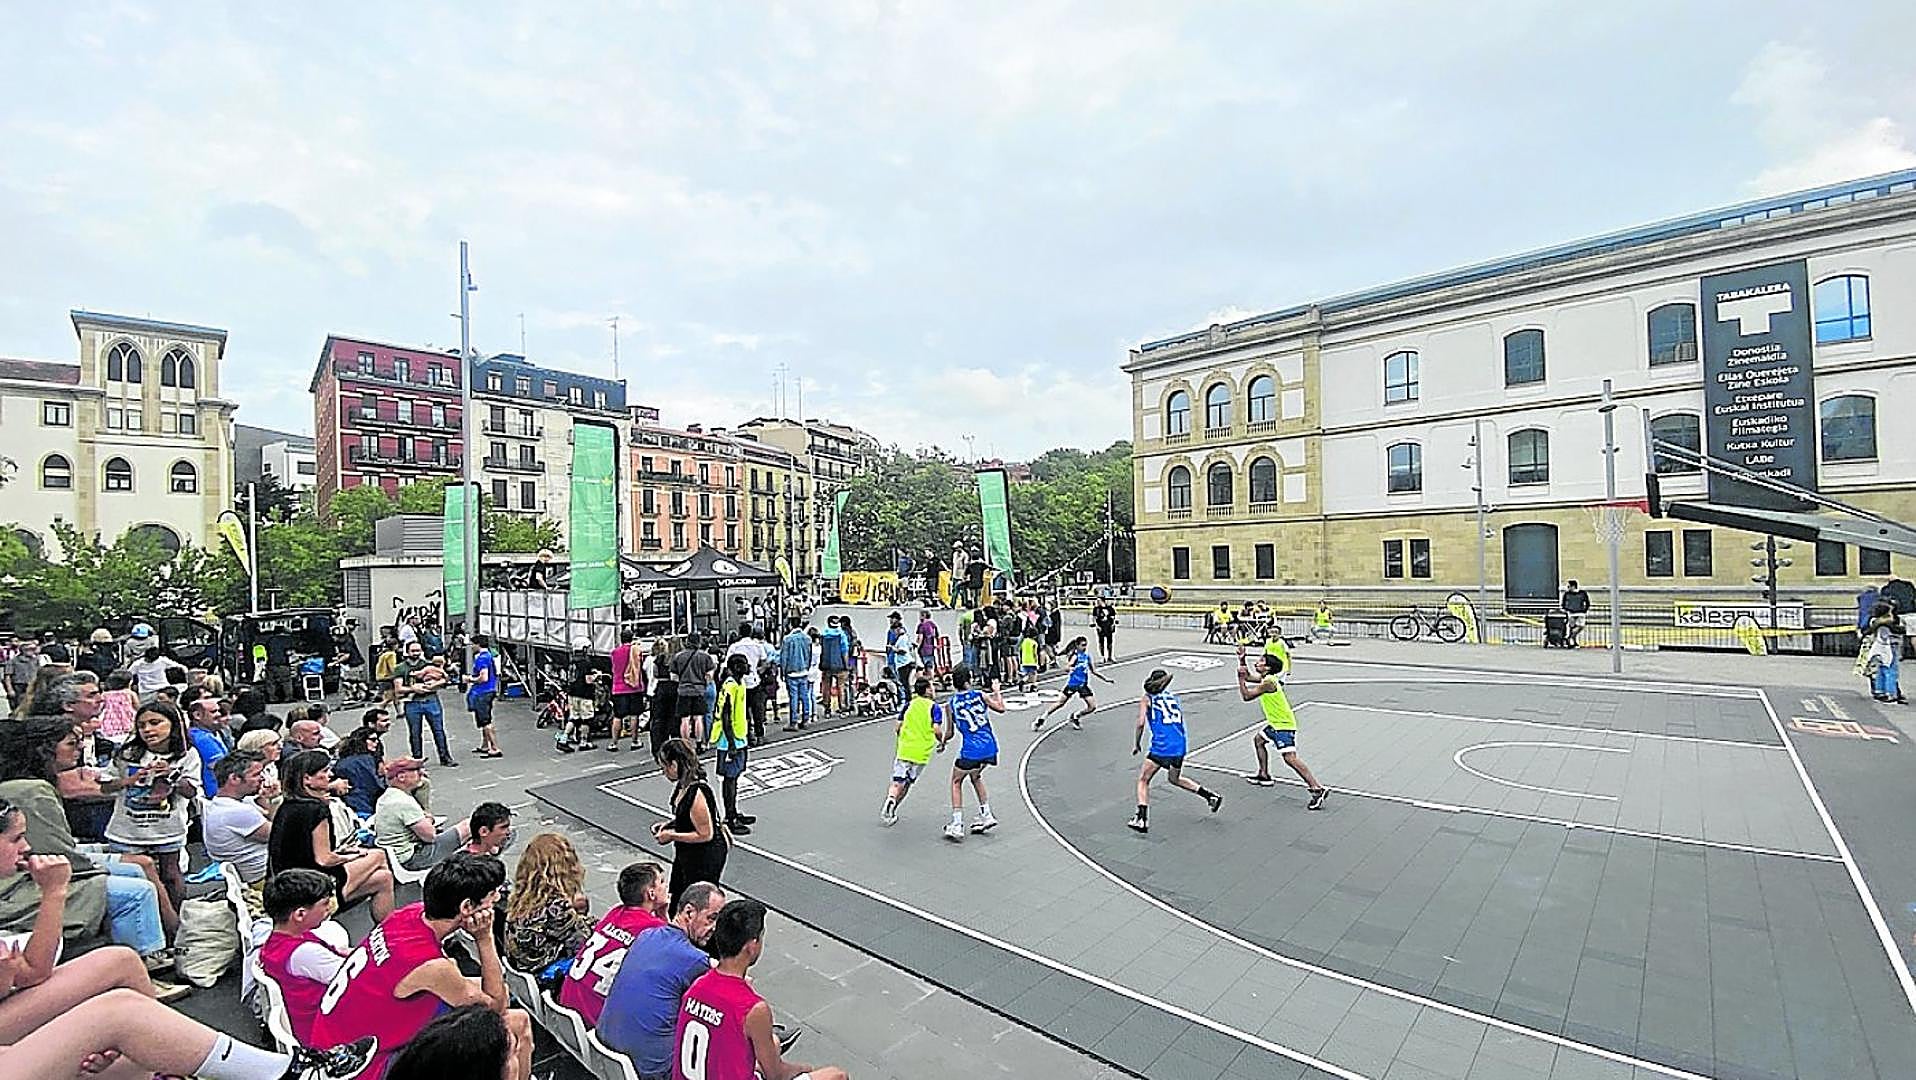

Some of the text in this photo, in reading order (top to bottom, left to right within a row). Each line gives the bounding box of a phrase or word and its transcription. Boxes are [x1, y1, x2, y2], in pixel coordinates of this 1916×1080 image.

[1716, 282, 1791, 301] TABAKALERA
[1732, 343, 1781, 357] Donostia
[1727, 352, 1787, 367] Zinemaldia
[1718, 366, 1799, 382] Elias Querejeta
[1727, 376, 1790, 390] Zine Eskola
[1714, 398, 1805, 415] Euskal Institutua
[1731, 415, 1788, 427] Euskadiko
[1731, 424, 1788, 436] Filmategia
[1726, 439, 1795, 451] Kutxa Kultur
[716, 578, 757, 587] VOLCOM
[1156, 699, 1182, 724] 15
[569, 931, 629, 995] 34
